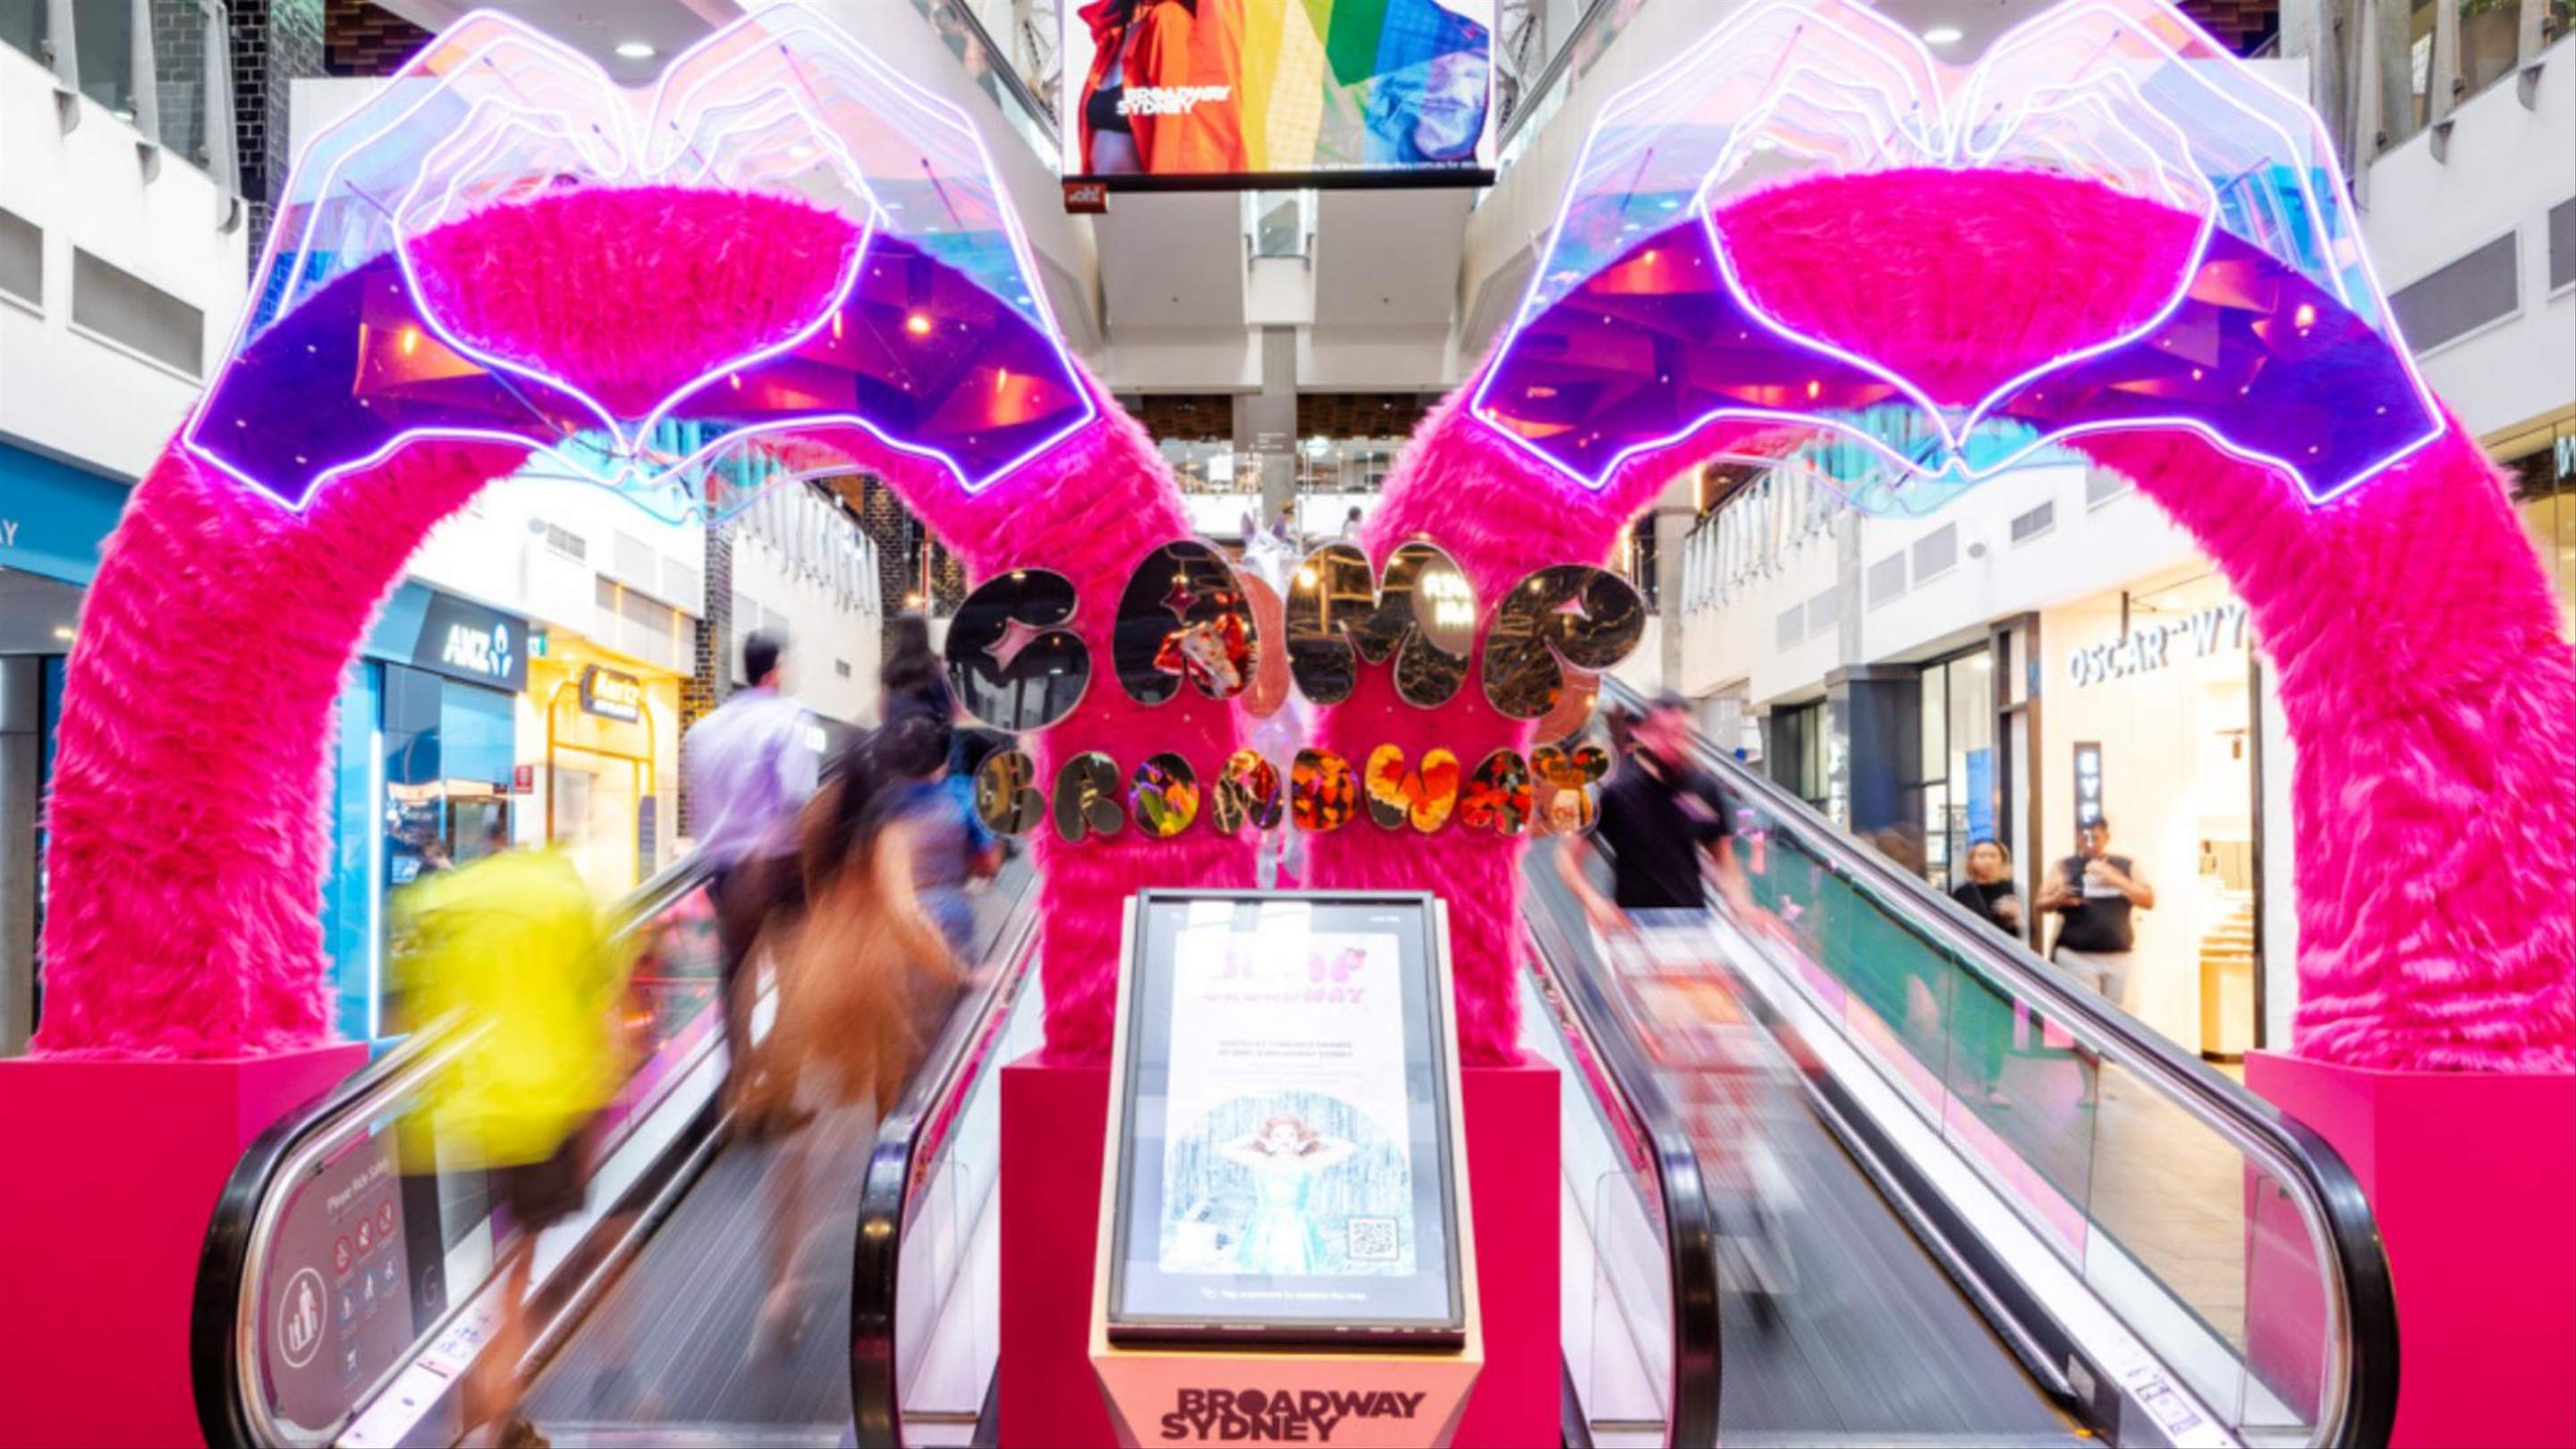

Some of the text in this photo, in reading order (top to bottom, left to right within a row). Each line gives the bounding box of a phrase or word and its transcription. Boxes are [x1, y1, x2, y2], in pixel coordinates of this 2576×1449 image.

[443, 623, 492, 672] ANZ
[943, 539, 1648, 733] CAMP
[2070, 624, 2169, 688] OSCAR
[973, 741, 1613, 843] BROADWAY
[1160, 1411, 1342, 1442] SYDNEY
[1177, 1388, 1427, 1419] BROADWAY
